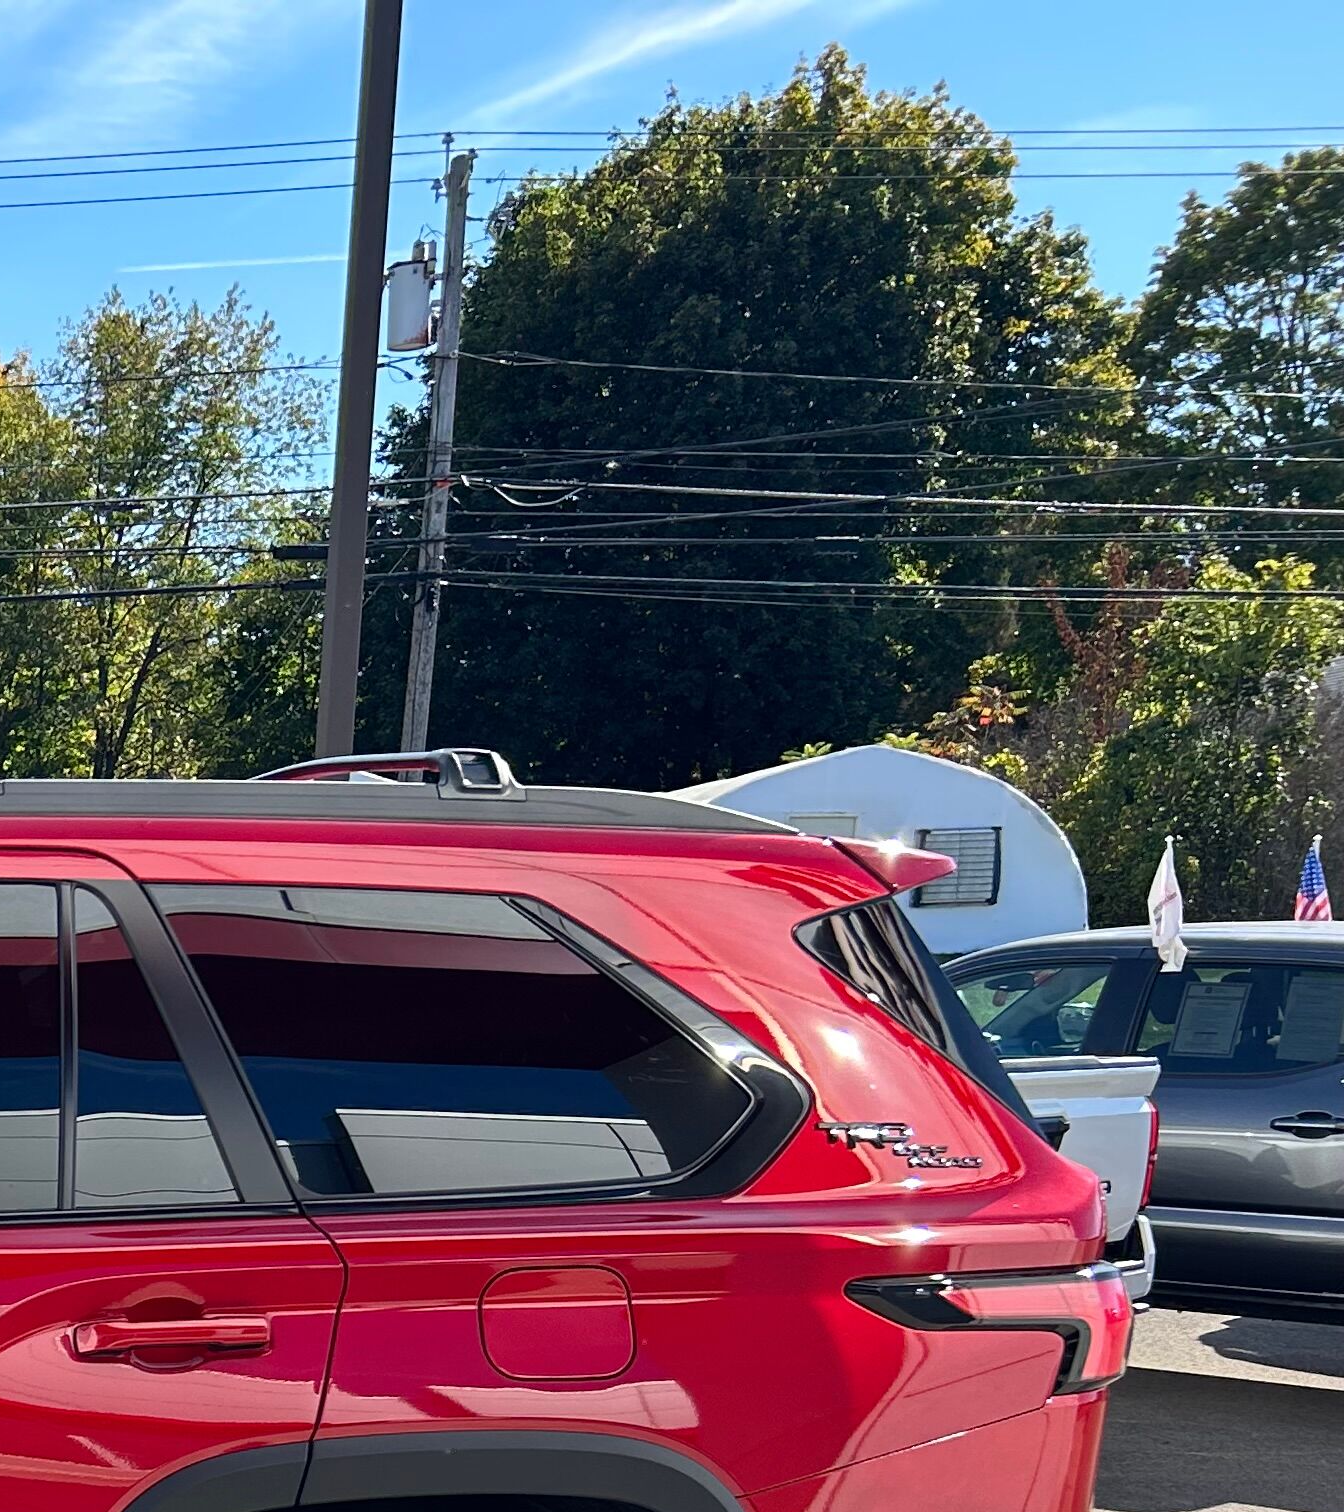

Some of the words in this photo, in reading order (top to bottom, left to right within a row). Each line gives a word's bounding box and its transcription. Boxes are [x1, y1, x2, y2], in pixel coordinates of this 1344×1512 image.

[815, 1122, 913, 1148] TRD
[892, 1143, 947, 1157] OFF
[907, 1156, 982, 1168] ROAD
